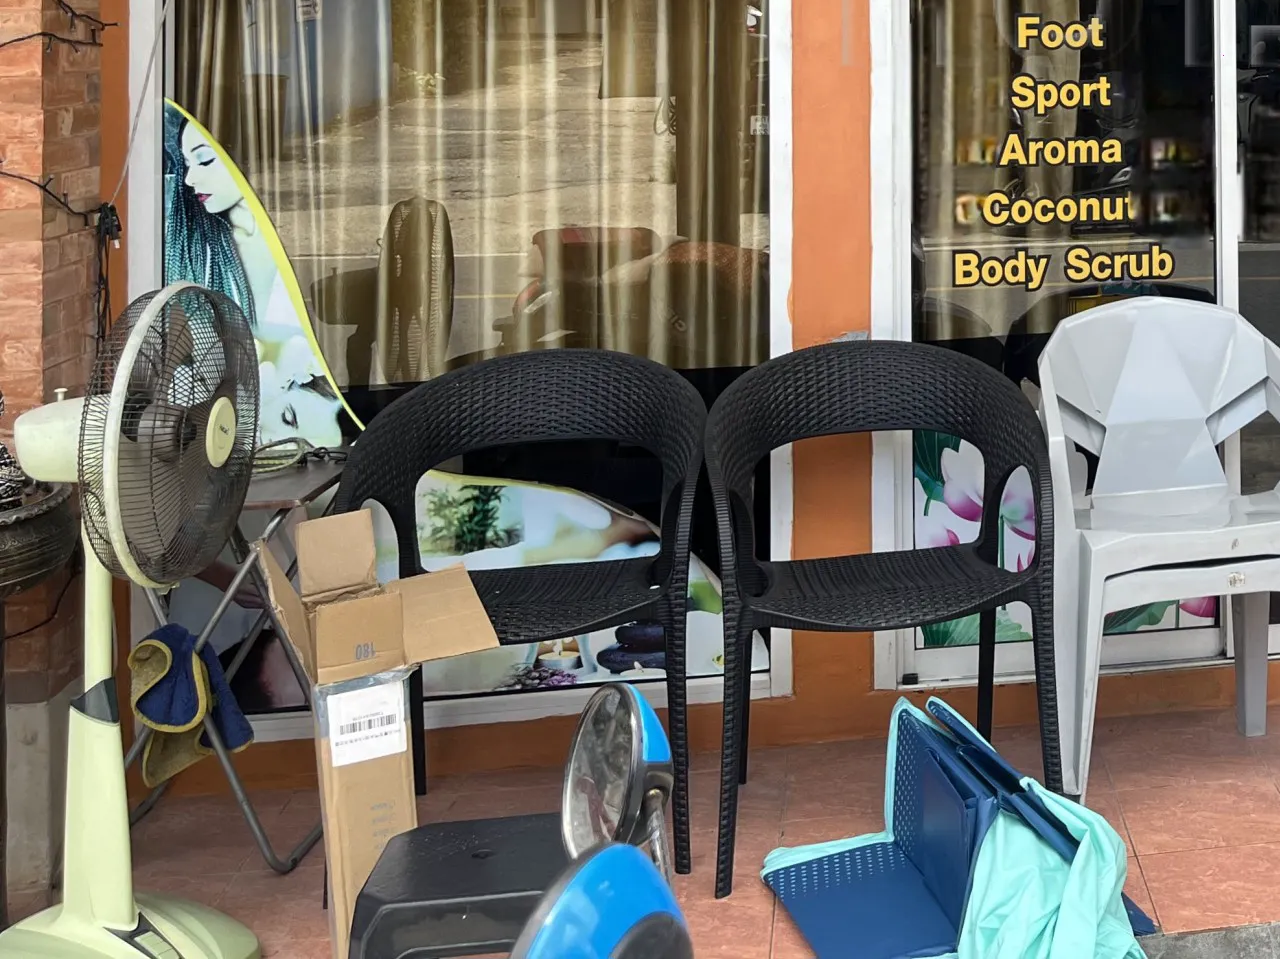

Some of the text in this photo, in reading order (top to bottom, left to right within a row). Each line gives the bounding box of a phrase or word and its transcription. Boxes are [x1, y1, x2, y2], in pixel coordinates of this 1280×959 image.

[1016, 16, 1105, 50] Foot
[1010, 75, 1112, 116] Sport
[998, 133, 1124, 167] Aroma
[953, 245, 1175, 291] Body Scrub
[354, 641, 376, 661] 180
